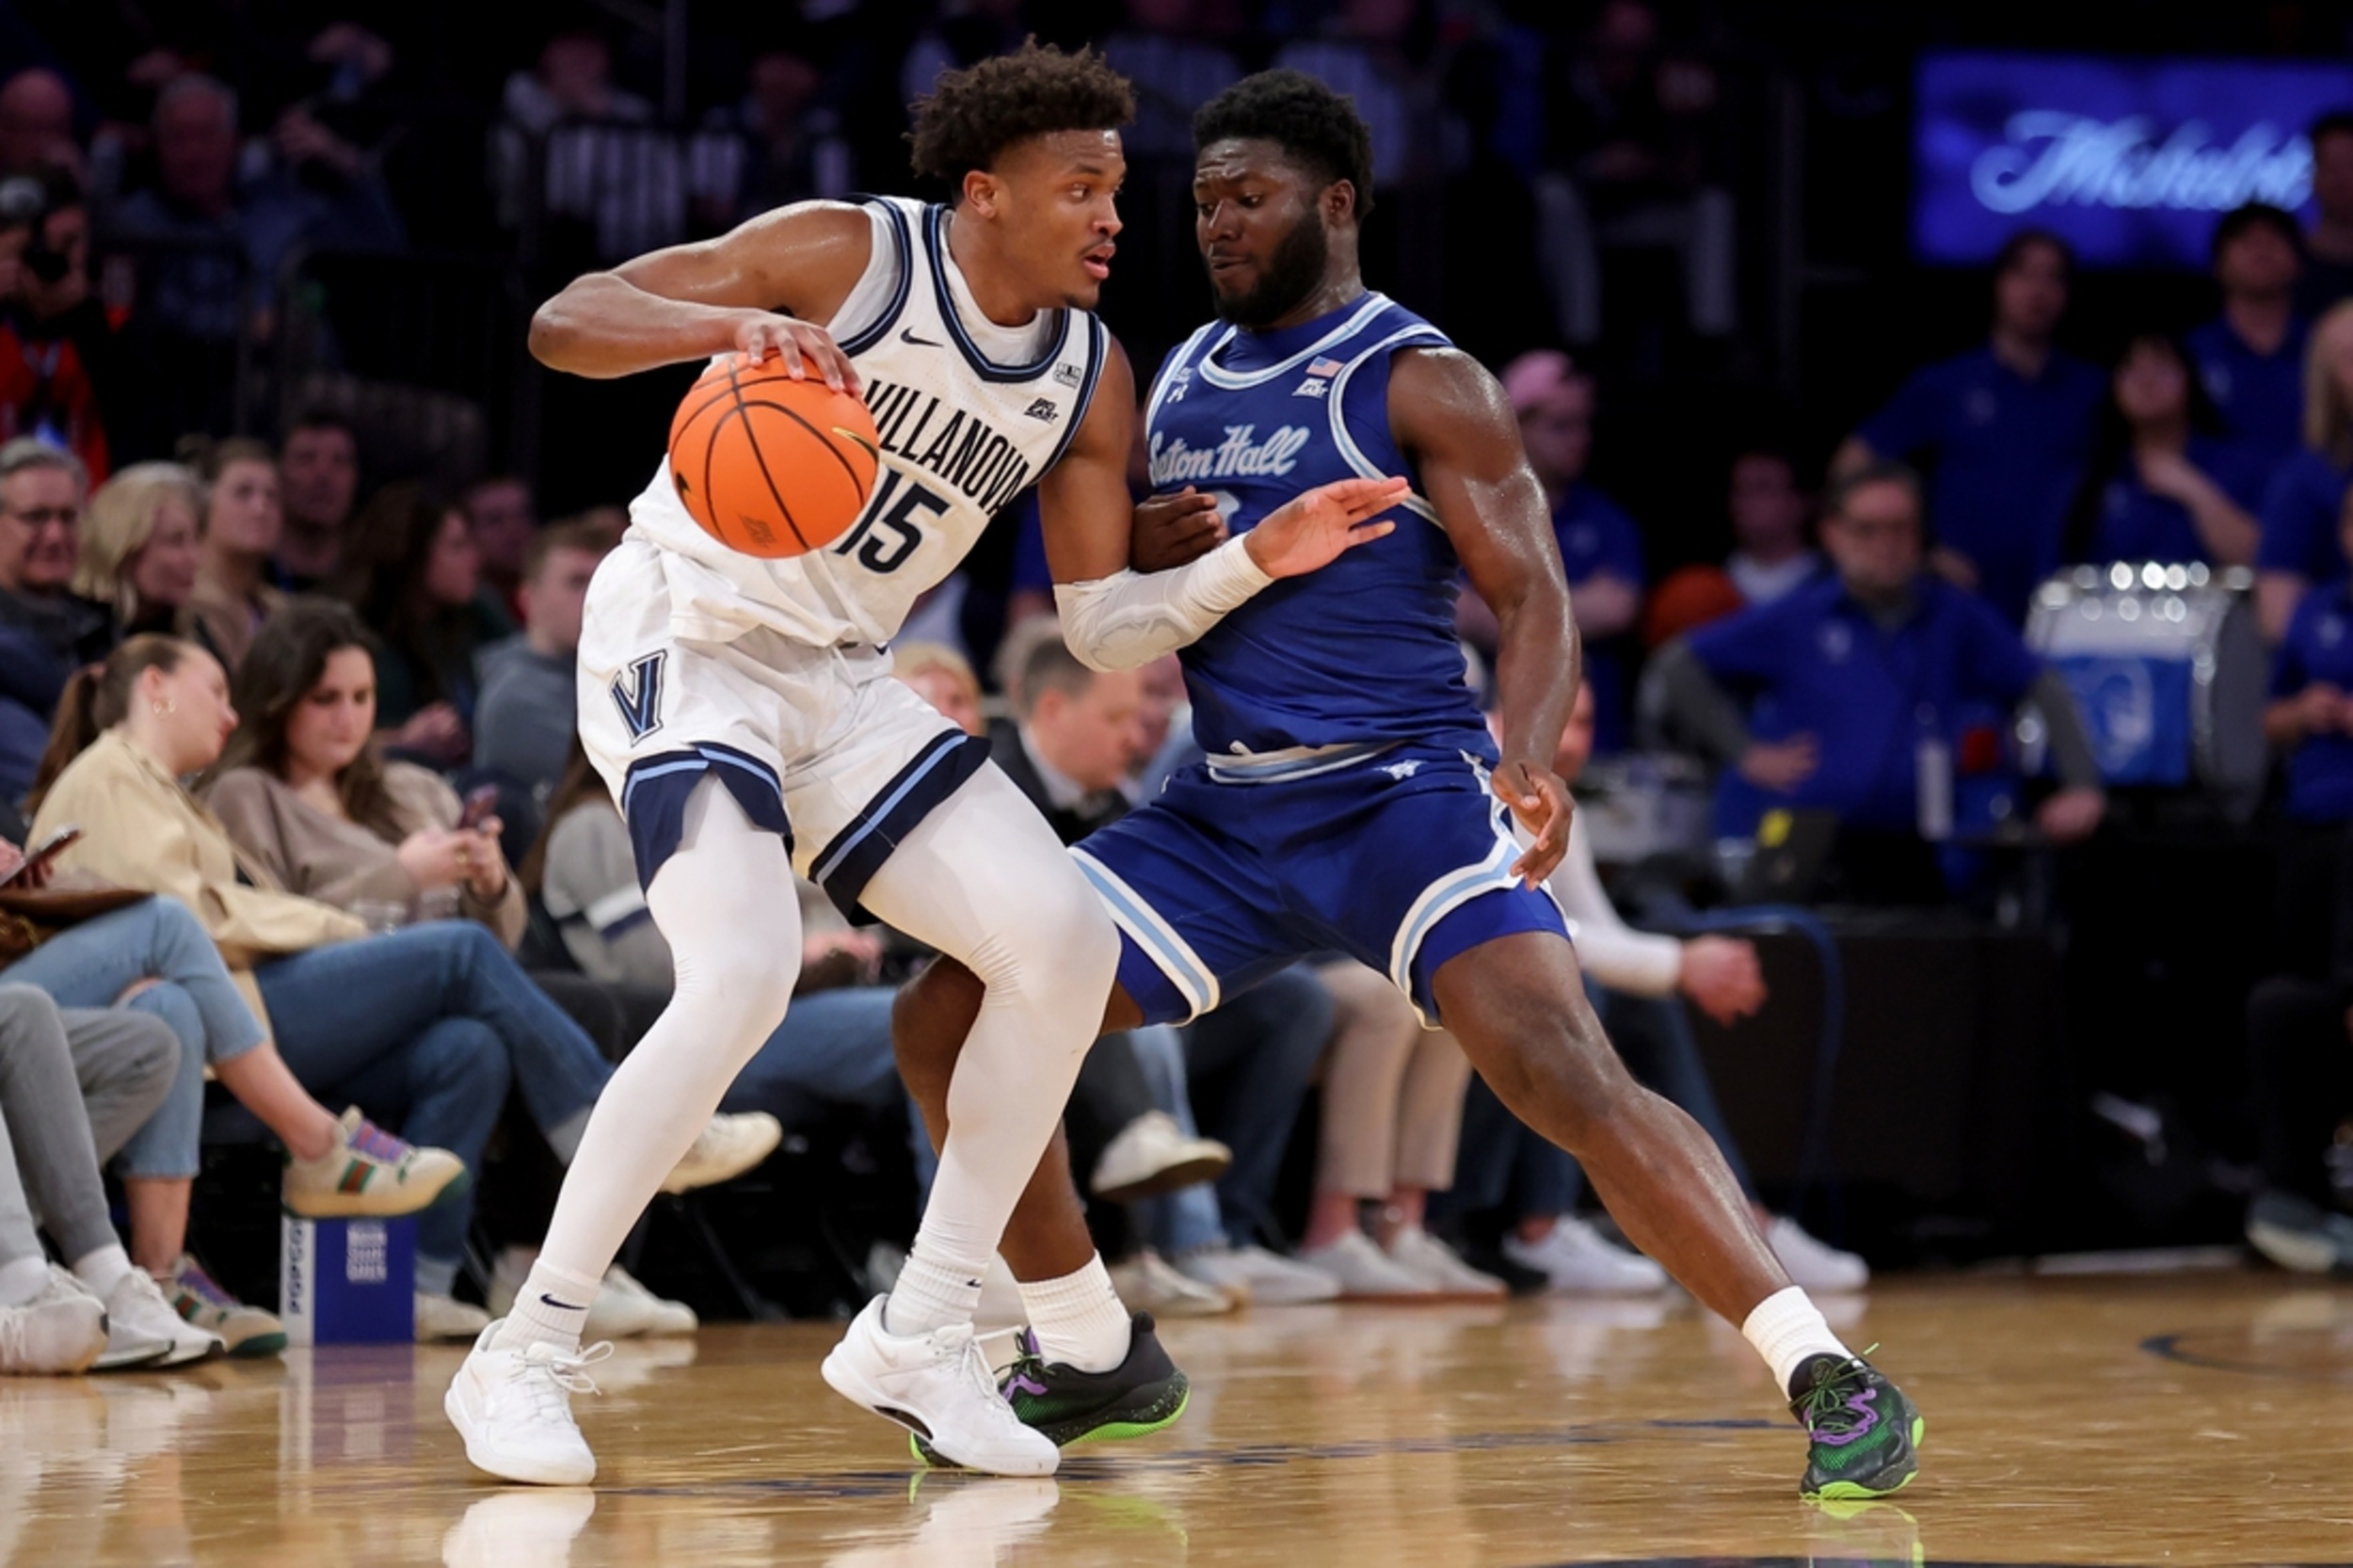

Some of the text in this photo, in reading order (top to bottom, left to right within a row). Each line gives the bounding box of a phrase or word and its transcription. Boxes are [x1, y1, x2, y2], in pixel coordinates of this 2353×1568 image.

[1212, 424, 1310, 476] Hall
[832, 466, 952, 574] 15
[608, 648, 668, 749] V
